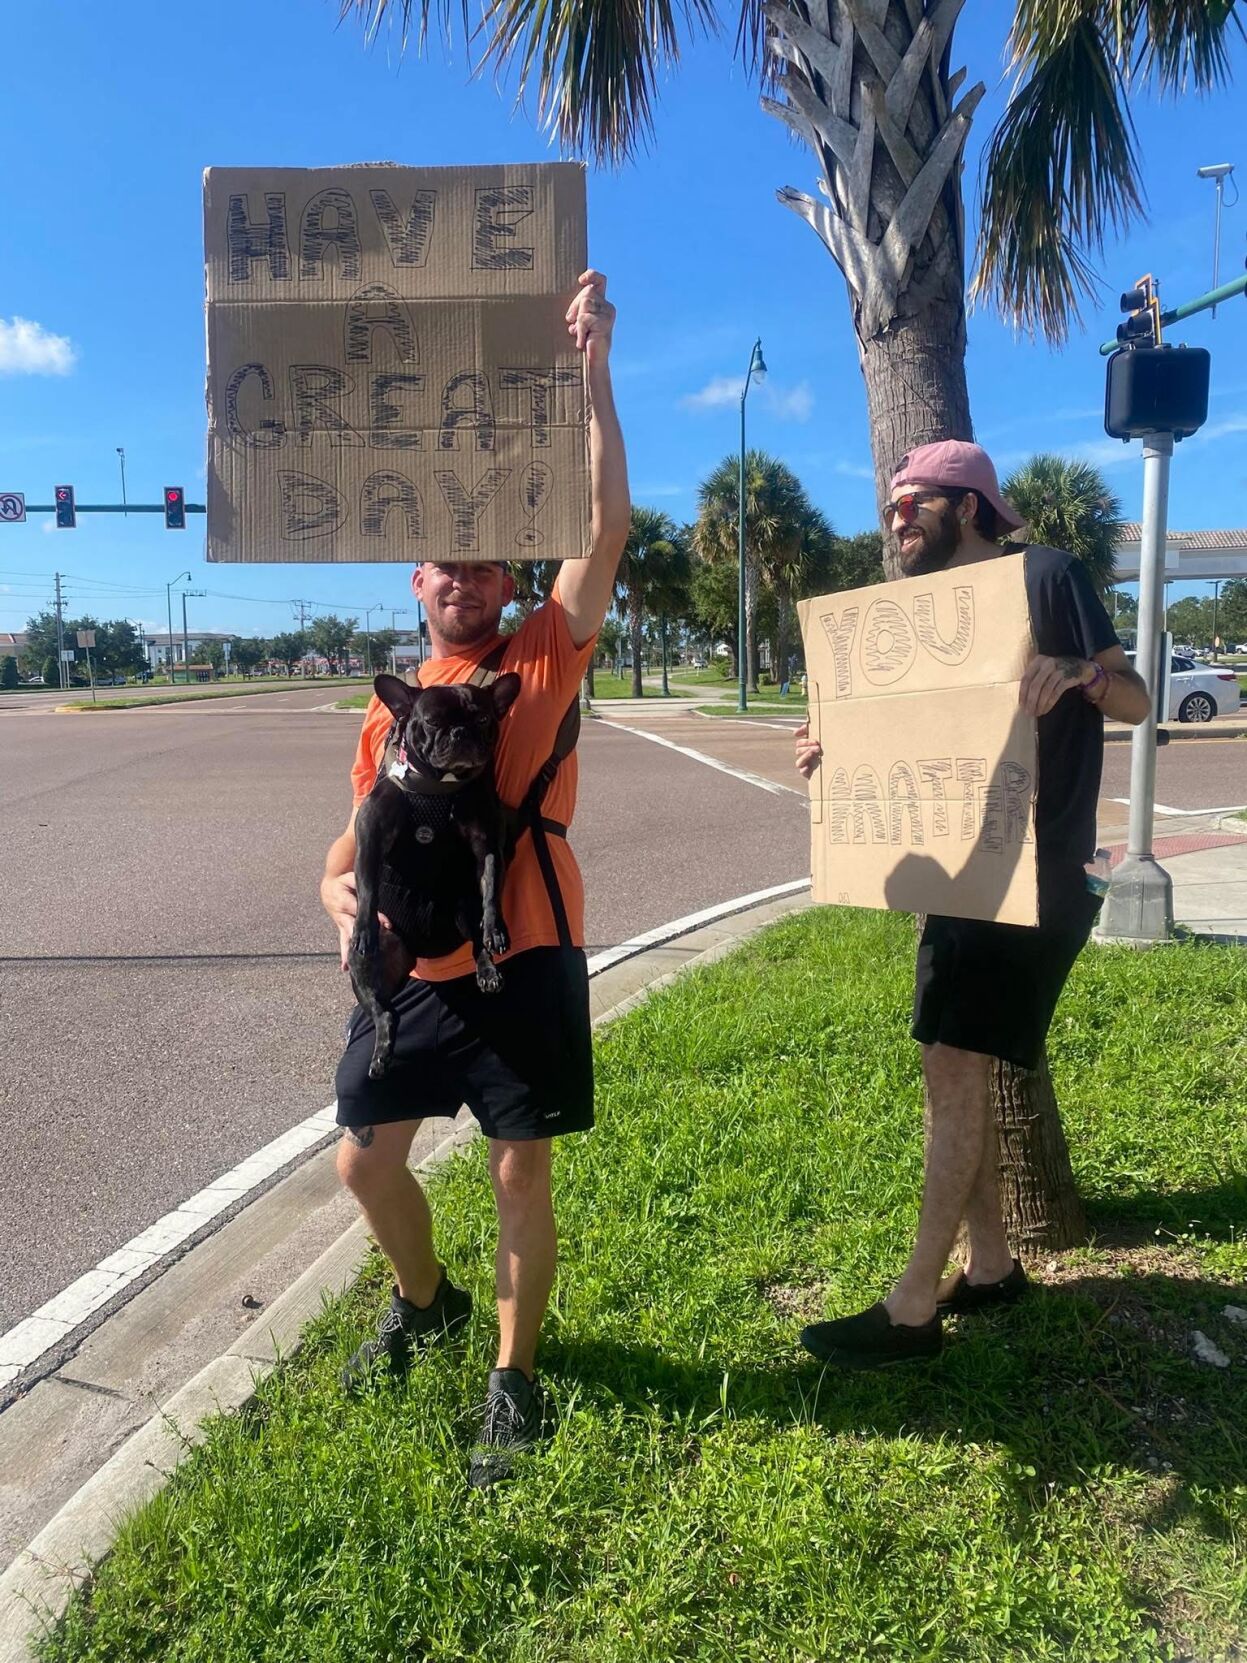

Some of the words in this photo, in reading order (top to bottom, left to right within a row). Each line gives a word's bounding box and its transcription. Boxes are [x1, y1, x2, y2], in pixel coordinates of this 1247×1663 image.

[226, 185, 535, 284] HAVE
[344, 280, 420, 364] A
[225, 362, 581, 452] GREAT
[277, 460, 554, 552] DAY!
[819, 586, 975, 698] YOU
[828, 758, 1034, 854] MATTER
